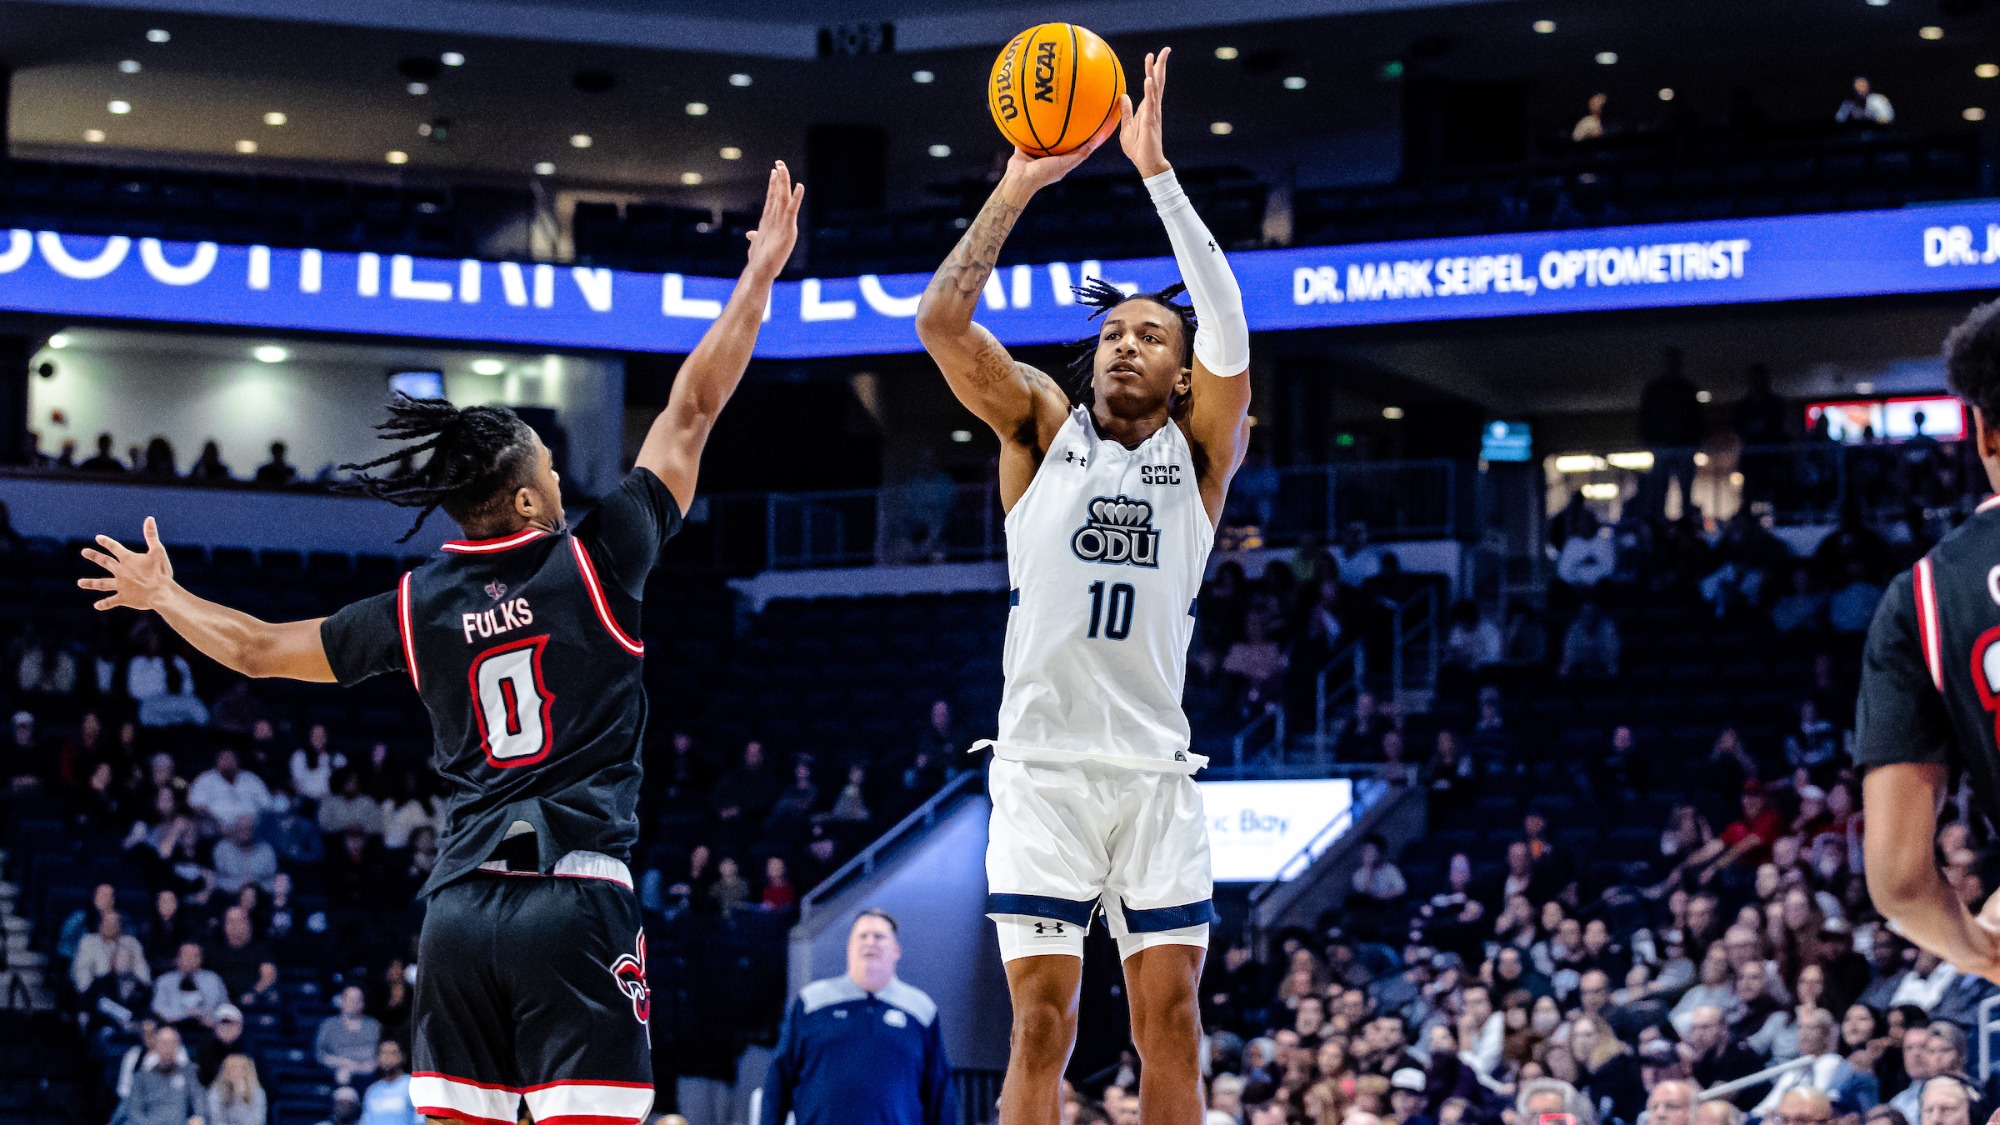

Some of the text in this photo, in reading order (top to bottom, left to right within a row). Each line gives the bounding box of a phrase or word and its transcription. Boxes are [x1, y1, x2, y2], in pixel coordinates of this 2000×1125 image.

[996, 36, 1025, 124] Wilson
[1034, 41, 1057, 104] NCAA
[1294, 239, 1751, 305] DR. MARK SEIPEL, OPTOMETRIST
[1923, 225, 1980, 268] DR.
[1140, 464, 1181, 486] SBC
[1073, 526, 1160, 567] ODU
[462, 597, 534, 644] FULKS
[1087, 580, 1136, 641] 10
[468, 634, 557, 769] 0
